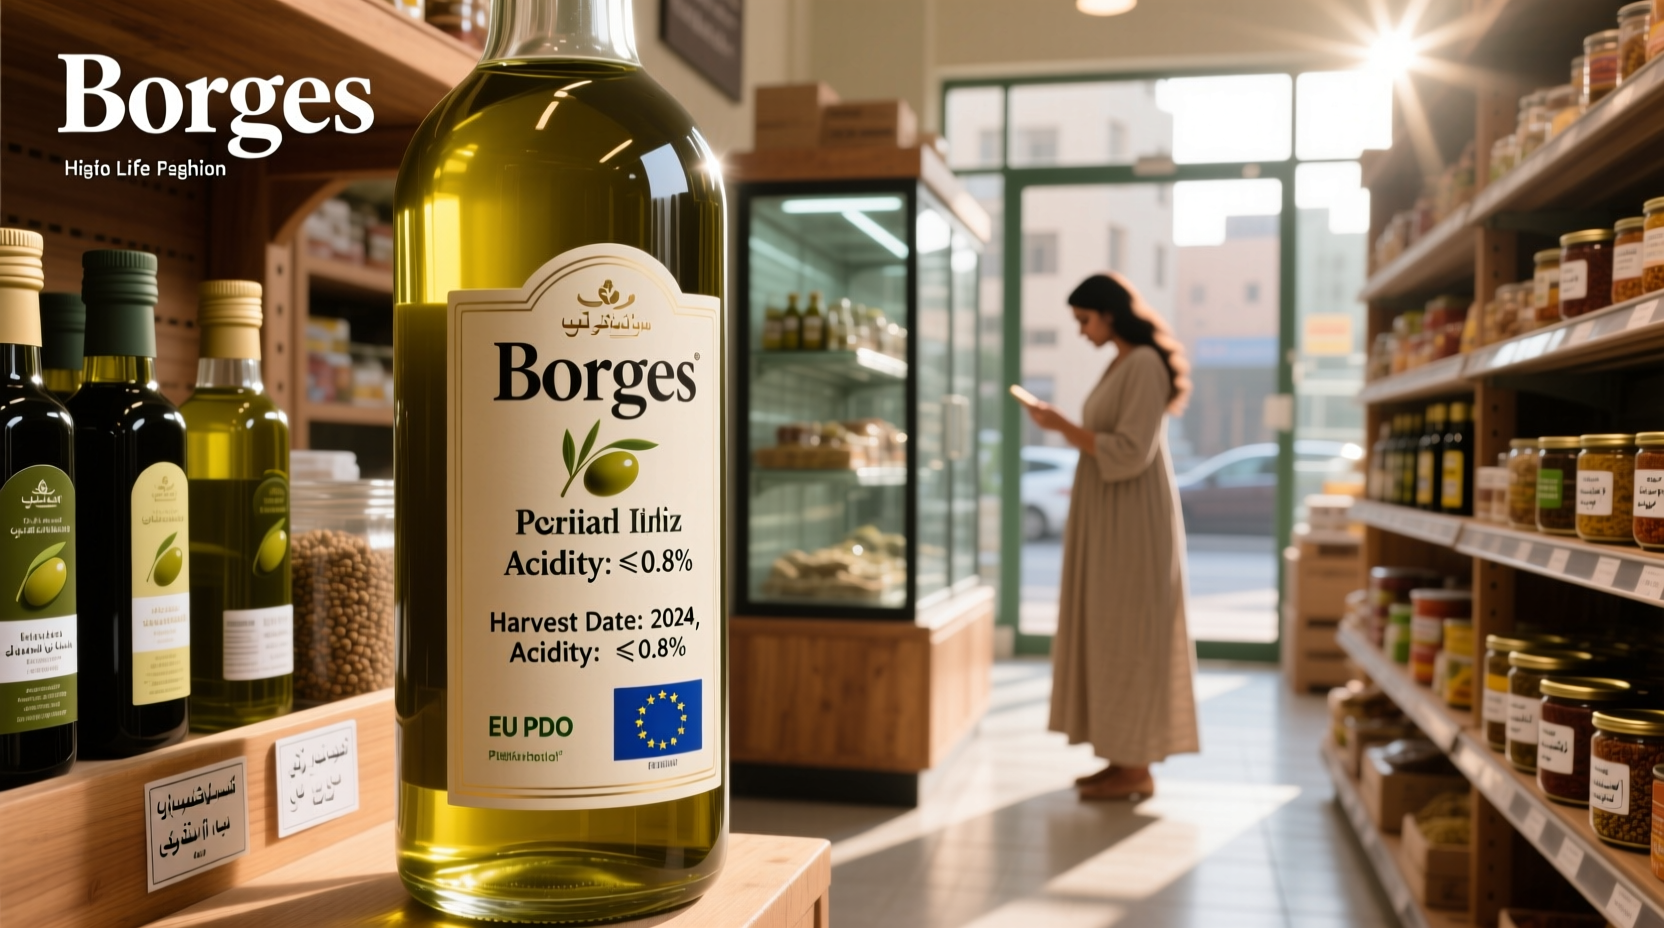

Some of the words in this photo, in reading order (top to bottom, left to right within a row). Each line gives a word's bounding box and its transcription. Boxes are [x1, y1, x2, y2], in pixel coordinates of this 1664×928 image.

[504, 549, 612, 583] Acidity:
[490, 611, 578, 633] Harvest
[585, 611, 643, 632] Date:
[650, 606, 700, 631] 2024,
[509, 640, 600, 668] Acidity:
[489, 715, 518, 738] EU
[523, 715, 574, 738] PDO
